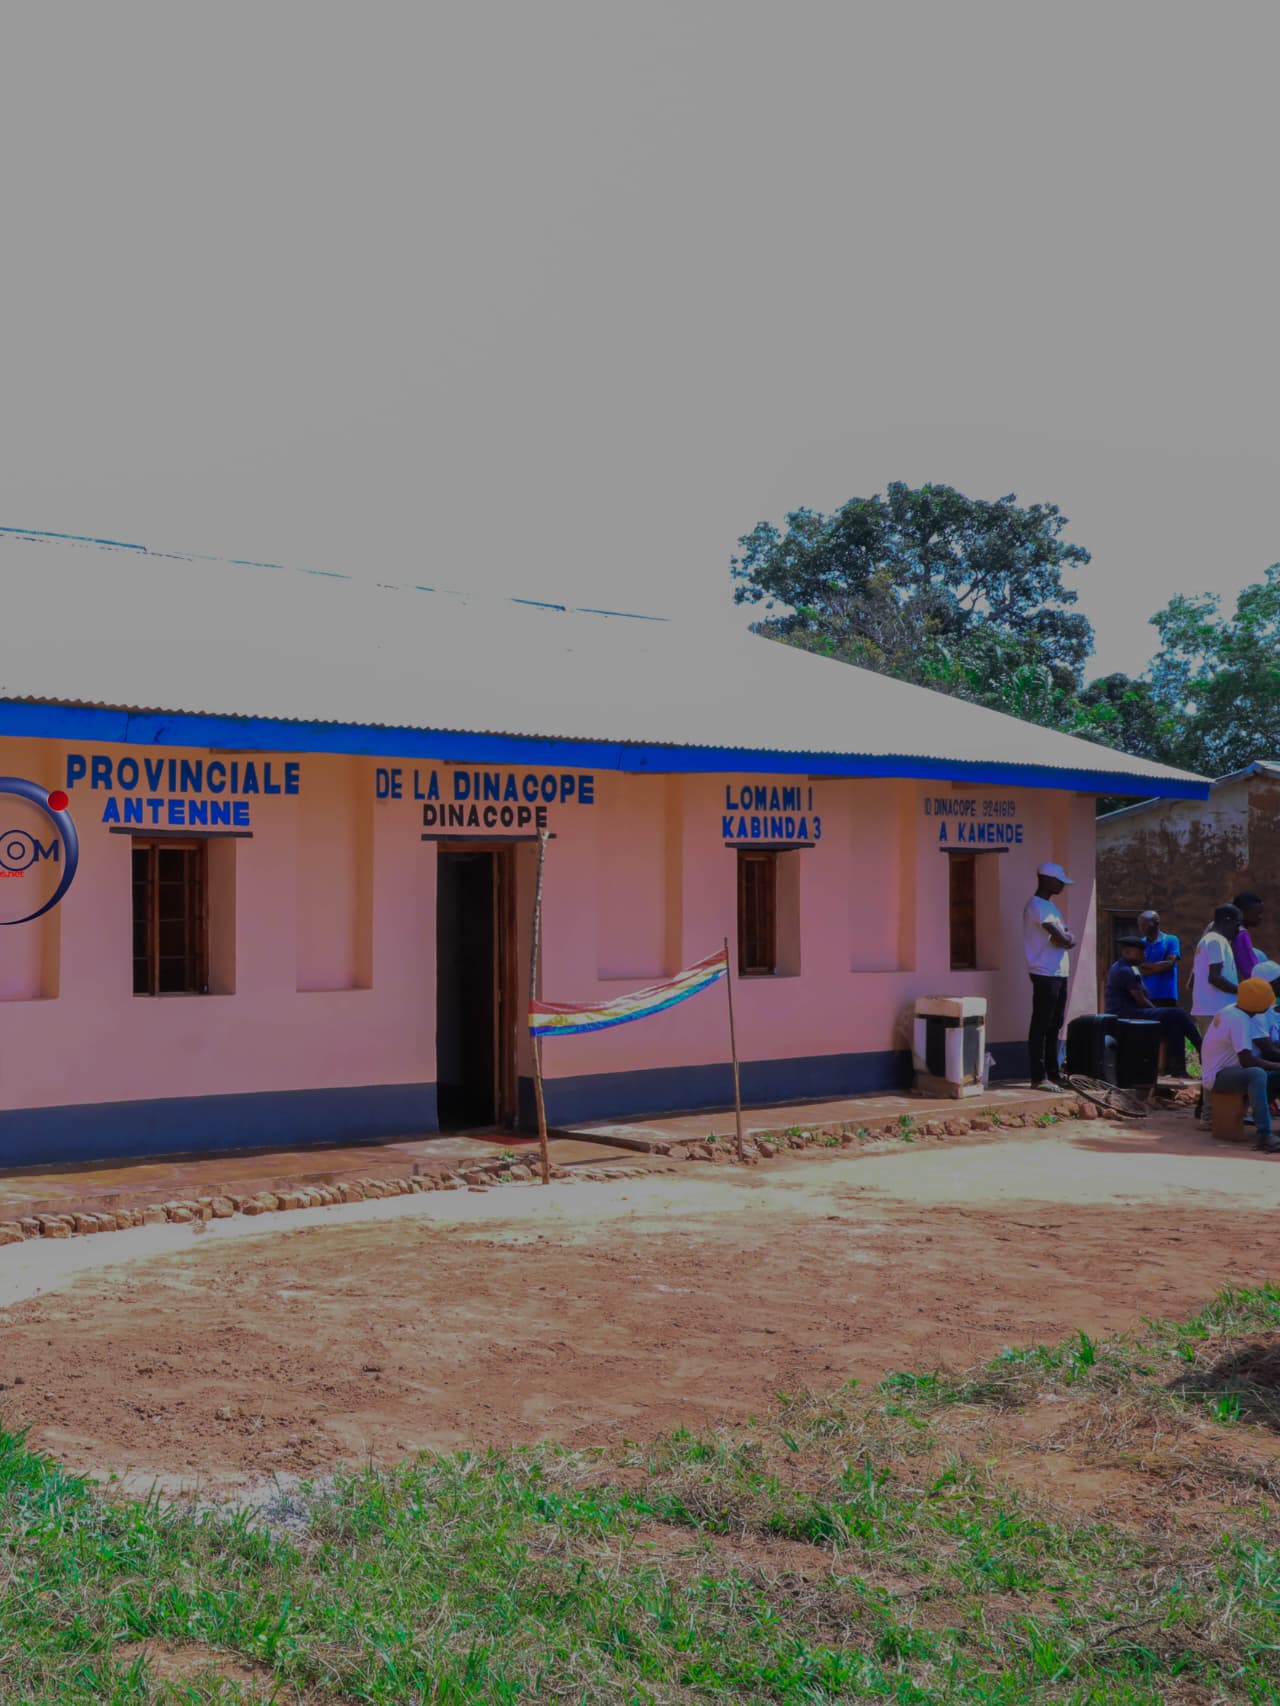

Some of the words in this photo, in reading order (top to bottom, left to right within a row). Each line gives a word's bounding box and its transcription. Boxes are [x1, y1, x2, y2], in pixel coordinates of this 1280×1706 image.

[67, 754, 301, 795] PROVINCIALE
[376, 768, 402, 799] DE
[414, 769, 440, 800] LA
[454, 770, 594, 804] DINACOPE
[726, 785, 802, 811] LOMAMI
[934, 799, 976, 817] DINACOPE
[102, 797, 250, 826] ANTENNE
[423, 804, 548, 828] DINACOPE
[722, 816, 808, 839] KABINDA
[813, 816, 821, 839] 3
[939, 821, 947, 842] A
[958, 822, 1023, 843] KAMENDE
